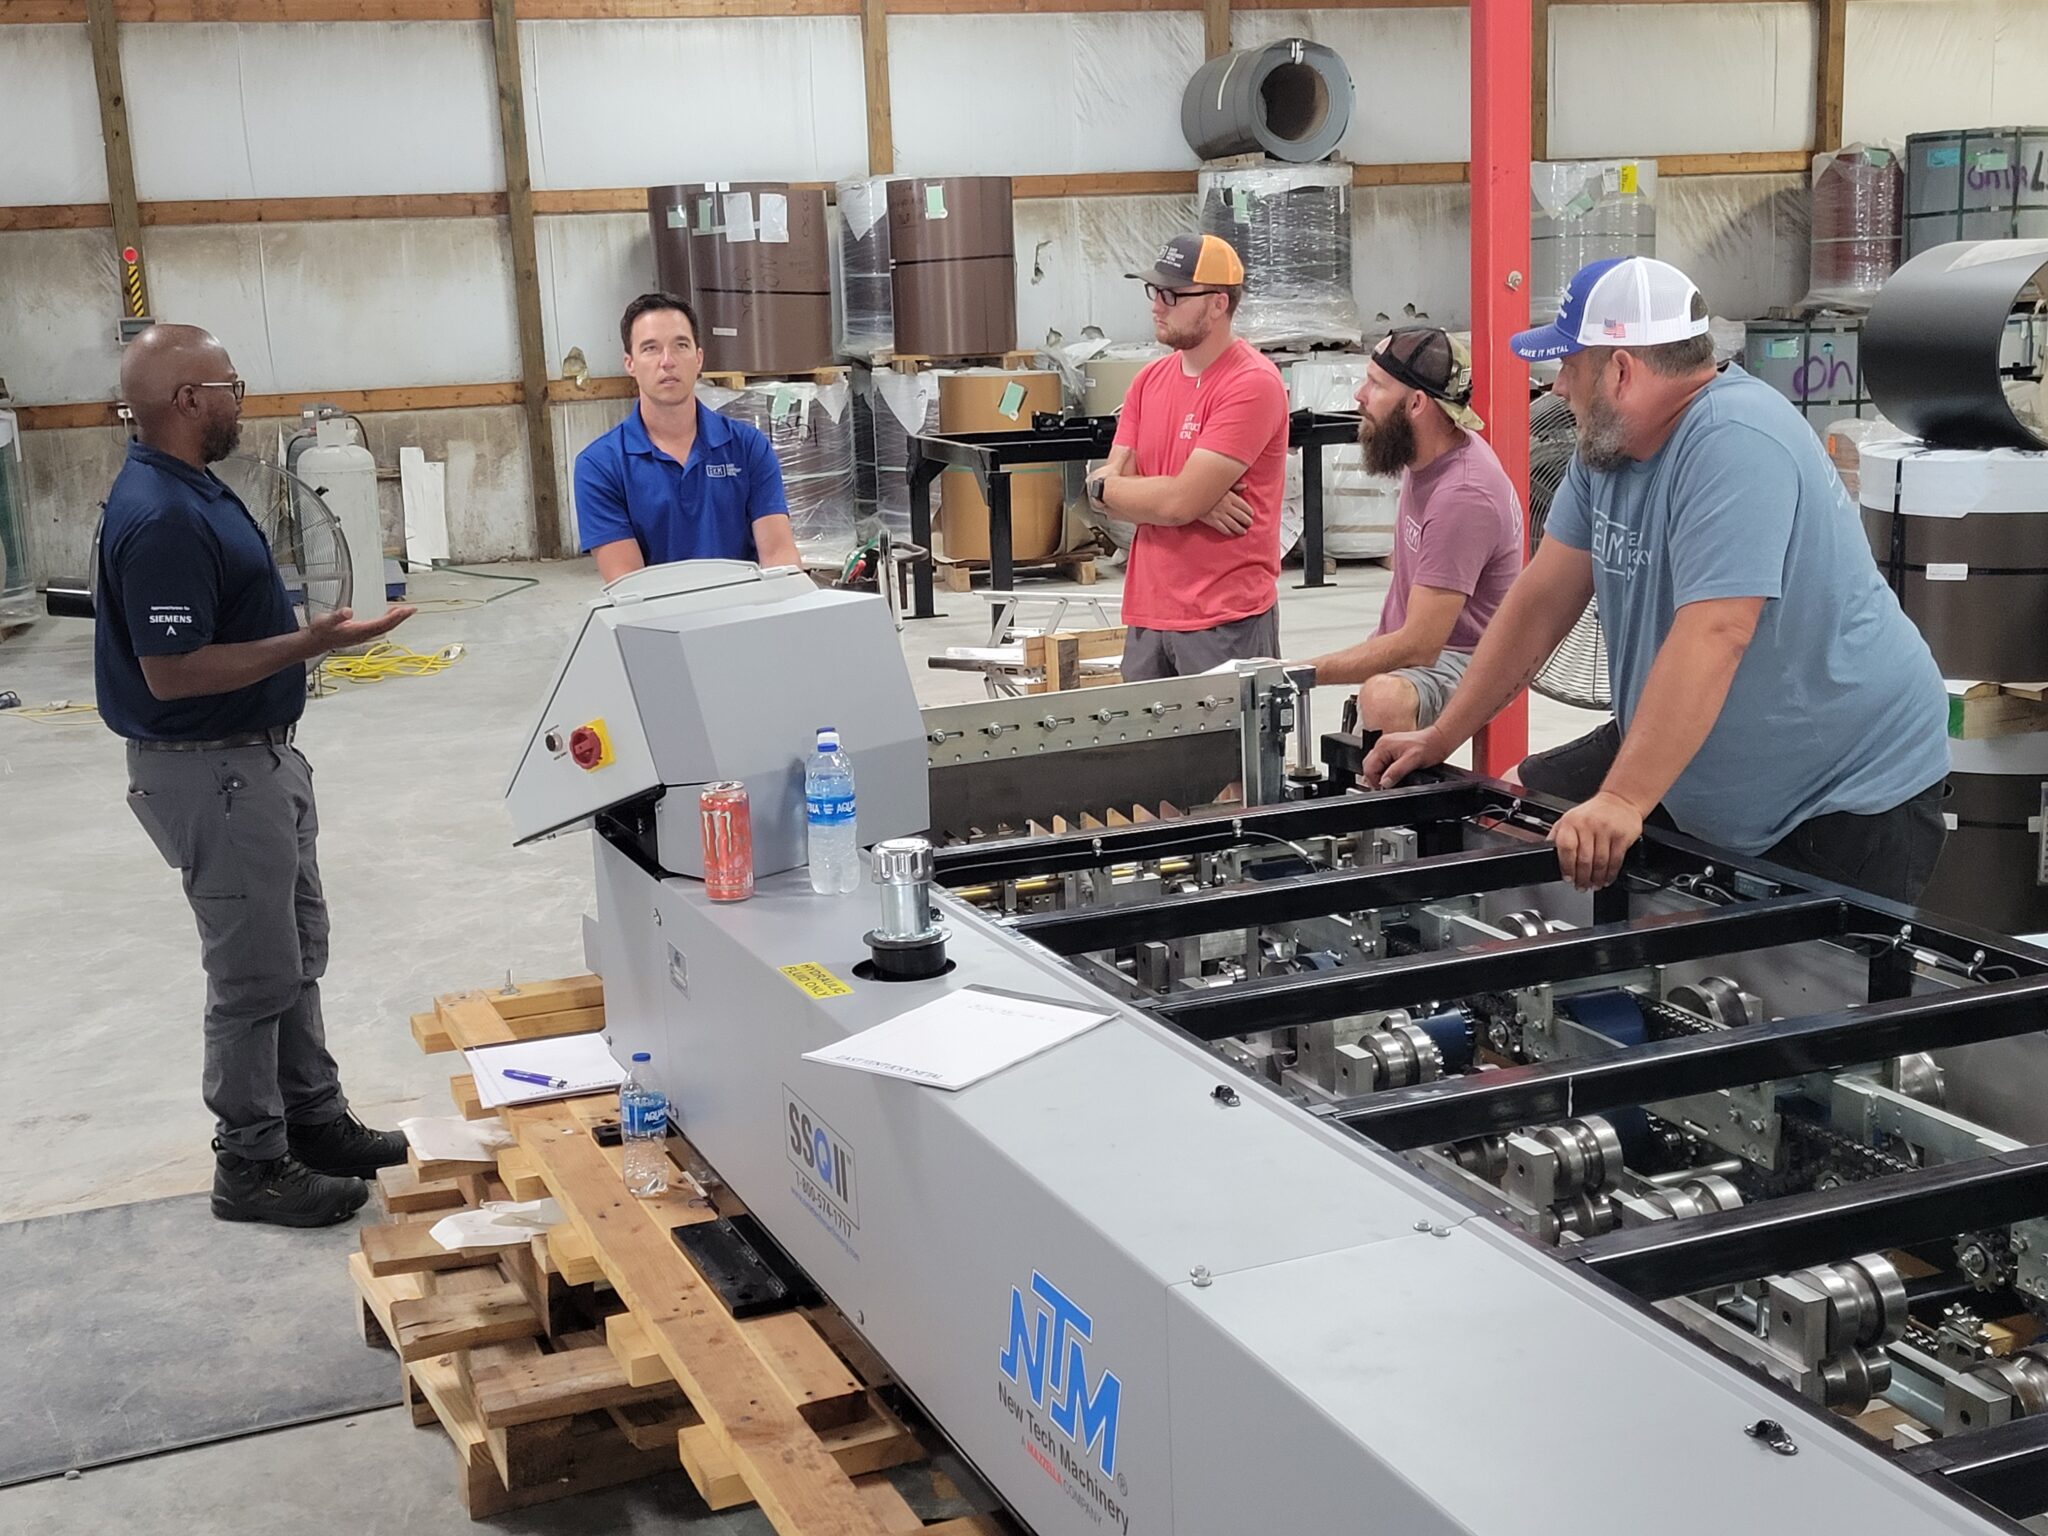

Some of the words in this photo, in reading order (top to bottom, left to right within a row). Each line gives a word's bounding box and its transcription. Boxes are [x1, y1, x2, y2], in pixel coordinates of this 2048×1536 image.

[1537, 349, 1545, 358] IT
[1546, 345, 1569, 357] METAL
[1593, 520, 1624, 566] EM
[149, 614, 192, 624] SIEMENS
[784, 966, 810, 983] FLUID
[804, 981, 831, 996] ONLY
[801, 963, 847, 994] HYDRAULIC
[796, 1170, 852, 1239] 1-800-574-1717
[999, 1268, 1122, 1482] NTM
[998, 1380, 1024, 1424] New
[1026, 1409, 1056, 1458] Tech
[1060, 1442, 1129, 1536] Machinery
[1063, 1479, 1103, 1527] COMPANY
